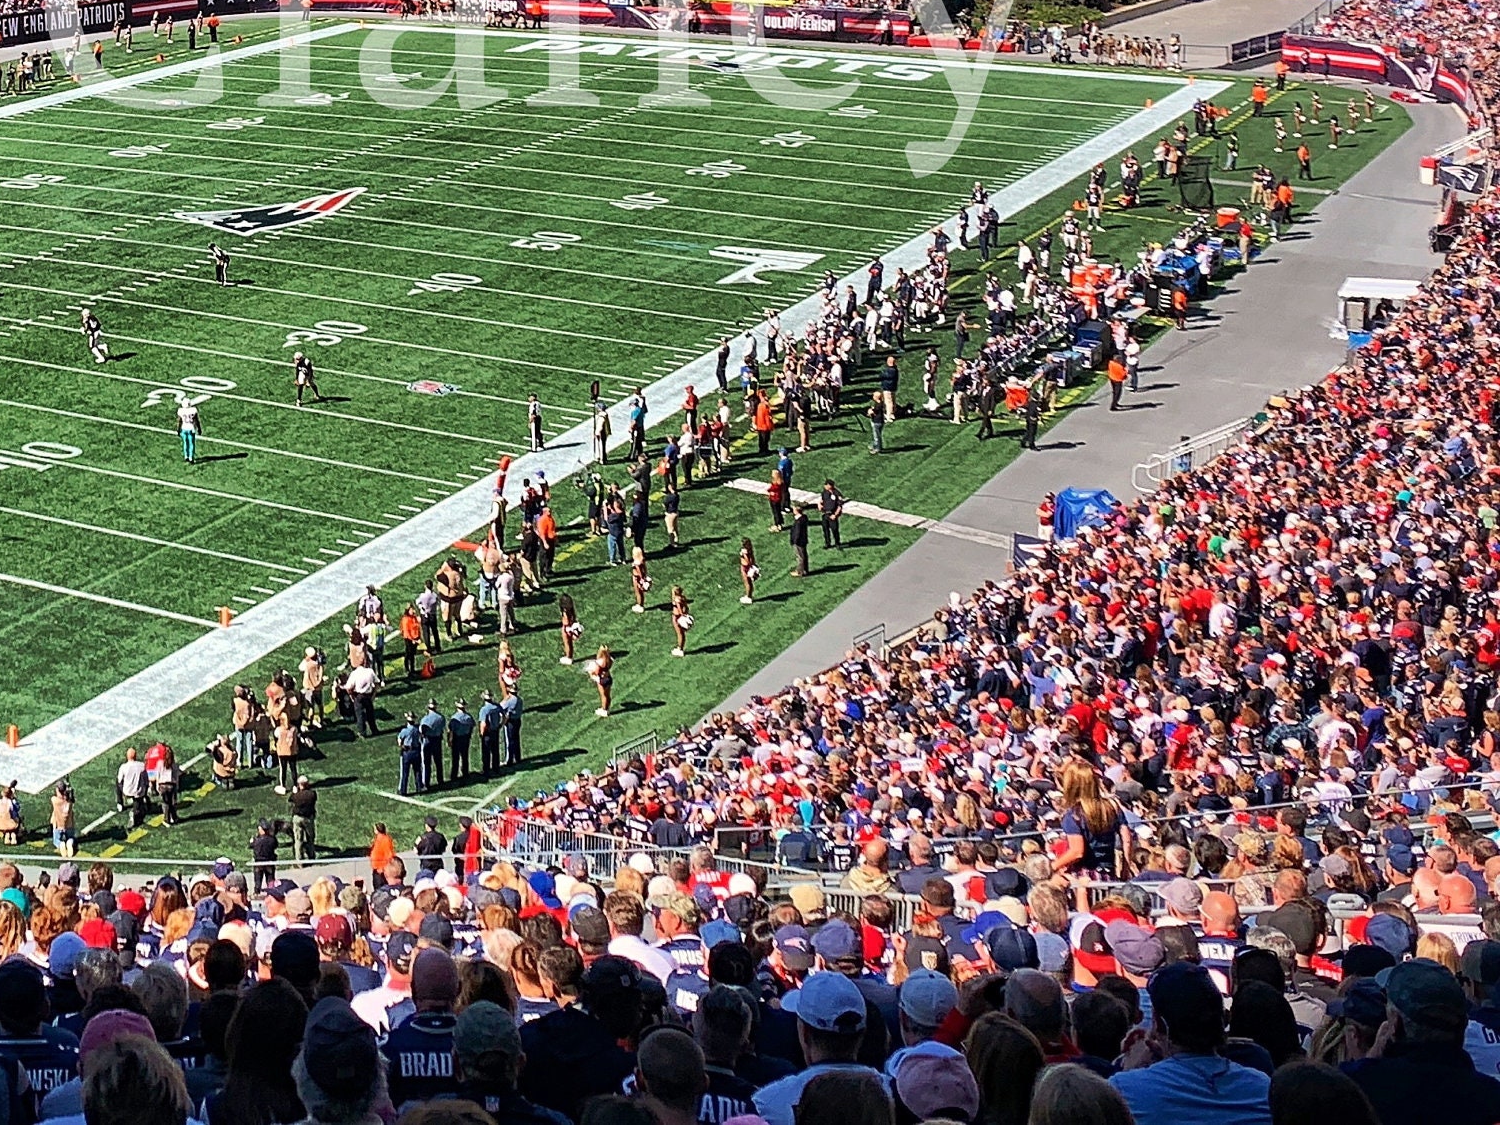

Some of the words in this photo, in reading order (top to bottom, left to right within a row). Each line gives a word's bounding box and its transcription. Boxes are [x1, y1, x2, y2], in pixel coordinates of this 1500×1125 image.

[24, 10, 72, 35] ENGLAND
[77, 2, 126, 27] PATRIOTS
[505, 40, 946, 81] PATRIOTS
[0, 173, 68, 190] 50
[509, 231, 583, 251] 50
[416, 272, 484, 294] 40
[284, 320, 369, 348] 30
[400, 1052, 454, 1078] BRAD
